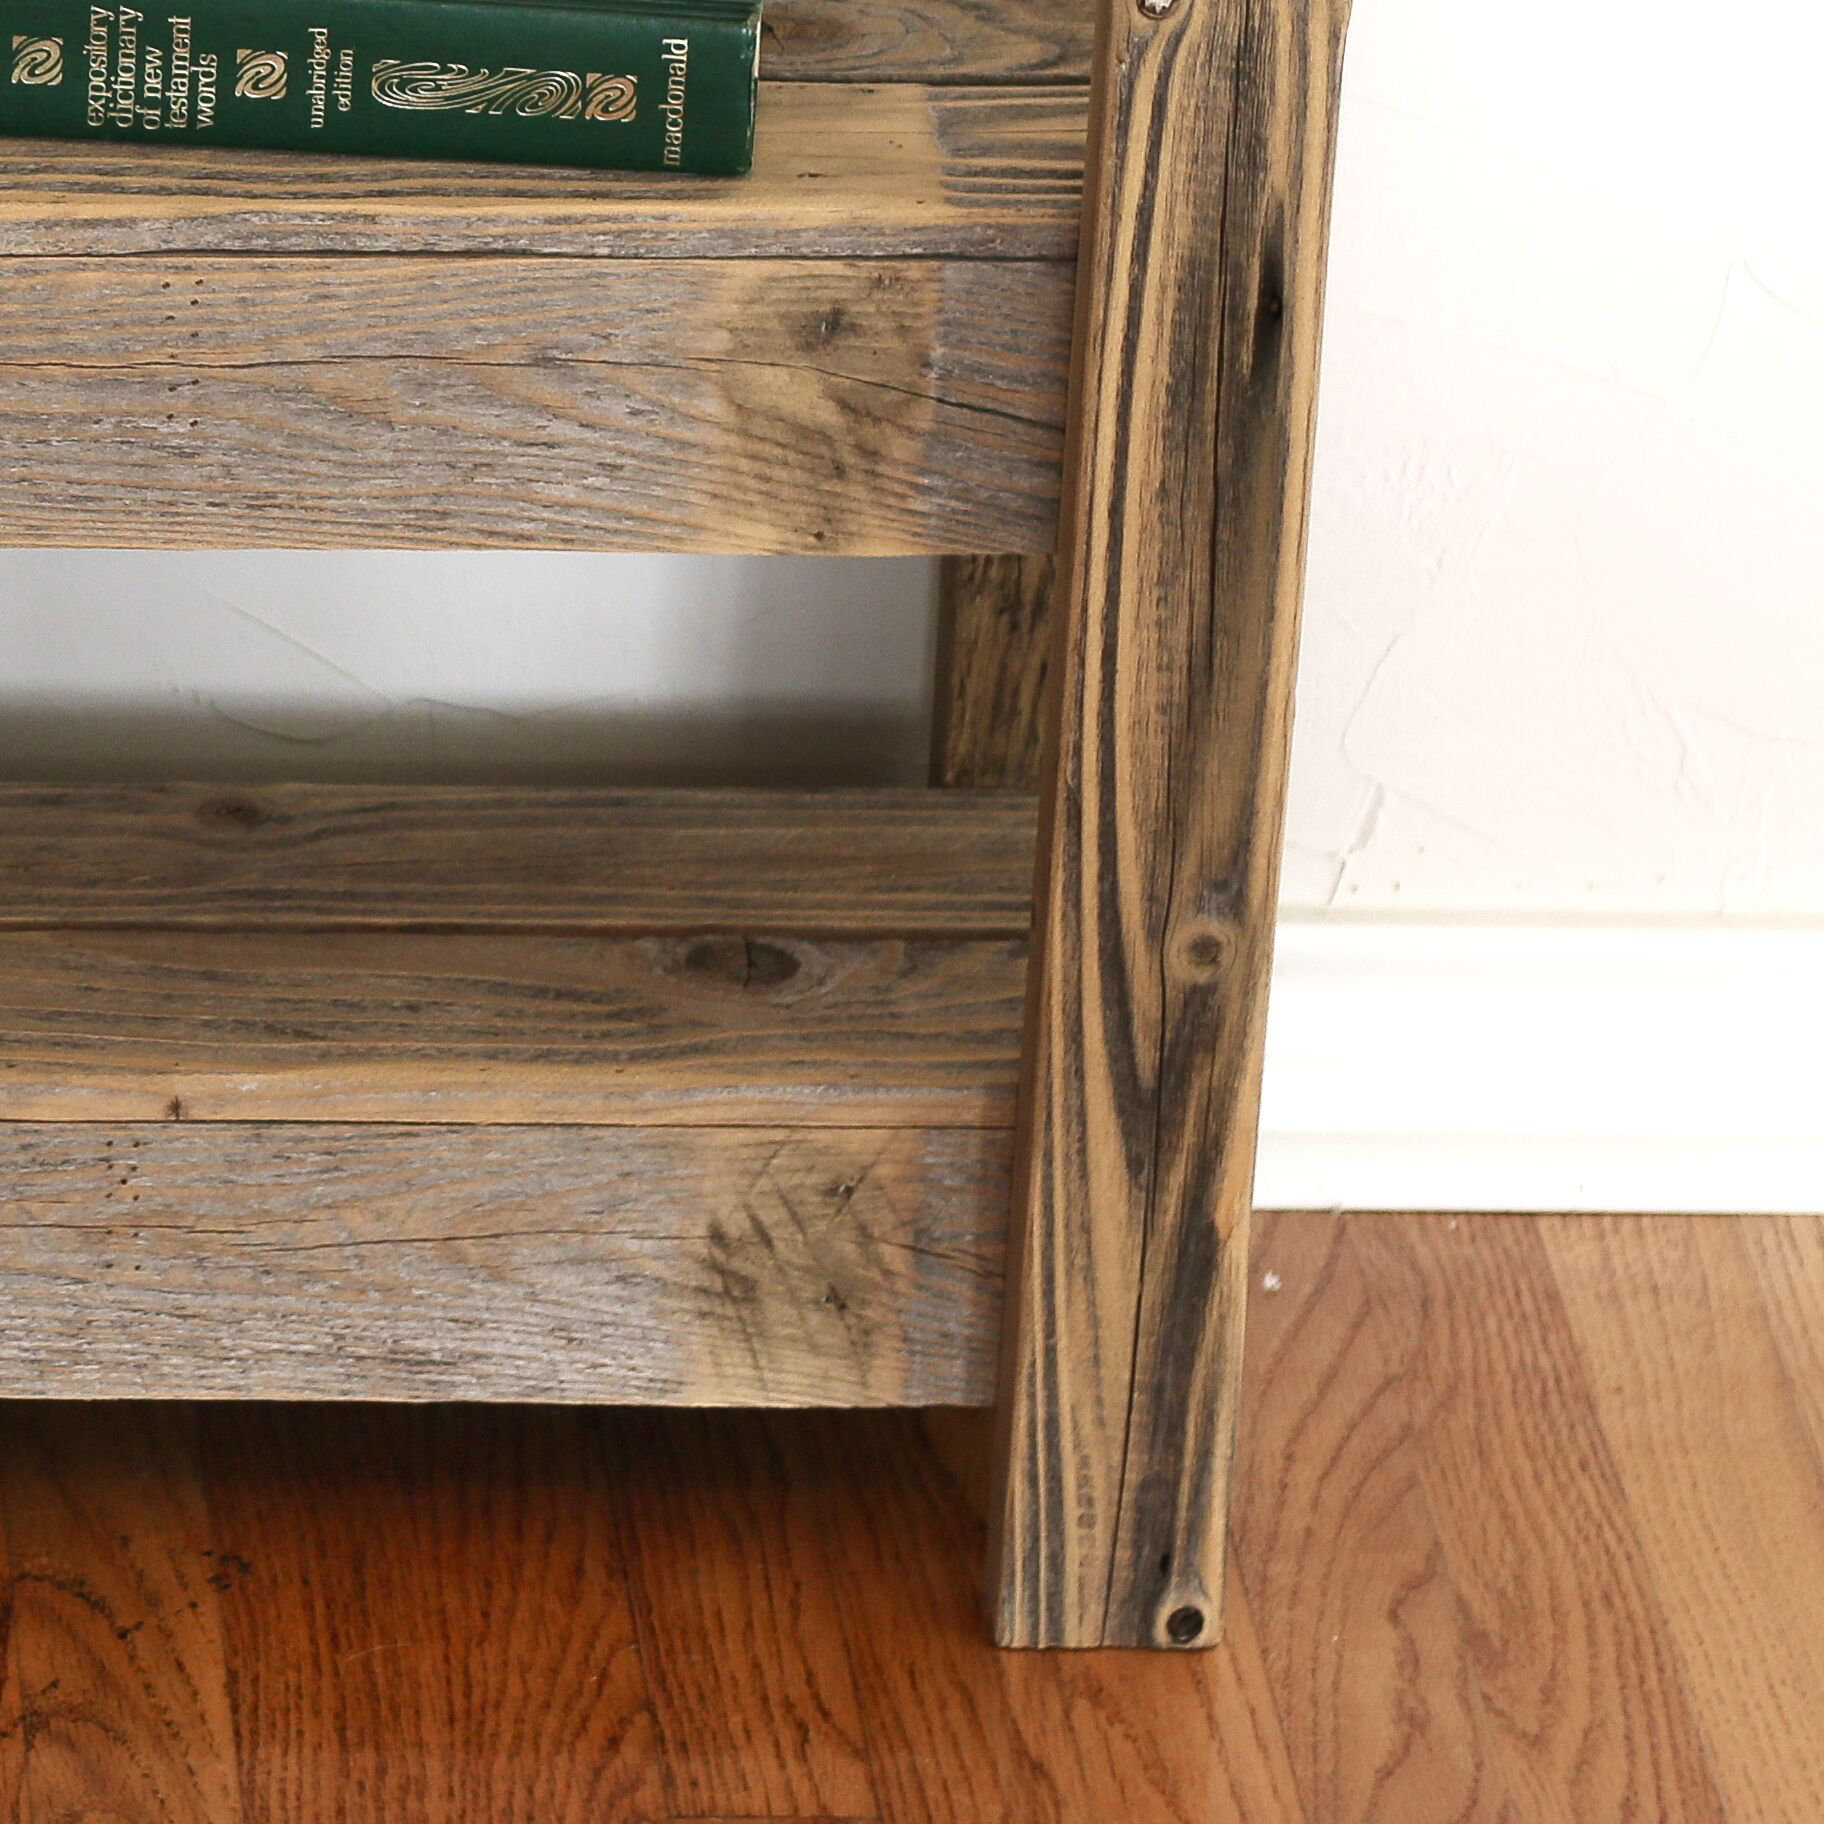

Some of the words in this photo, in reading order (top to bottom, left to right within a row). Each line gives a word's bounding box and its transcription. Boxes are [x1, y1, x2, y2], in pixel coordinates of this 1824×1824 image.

[82, 4, 115, 127] expository
[106, 4, 144, 128] dictionary
[143, 45, 164, 100] new
[163, 15, 192, 129] testament
[189, 53, 218, 130] words
[305, 27, 332, 129] unabridged
[331, 49, 354, 112] edition
[657, 37, 689, 166] macdonald
[135, 104, 162, 130] of
